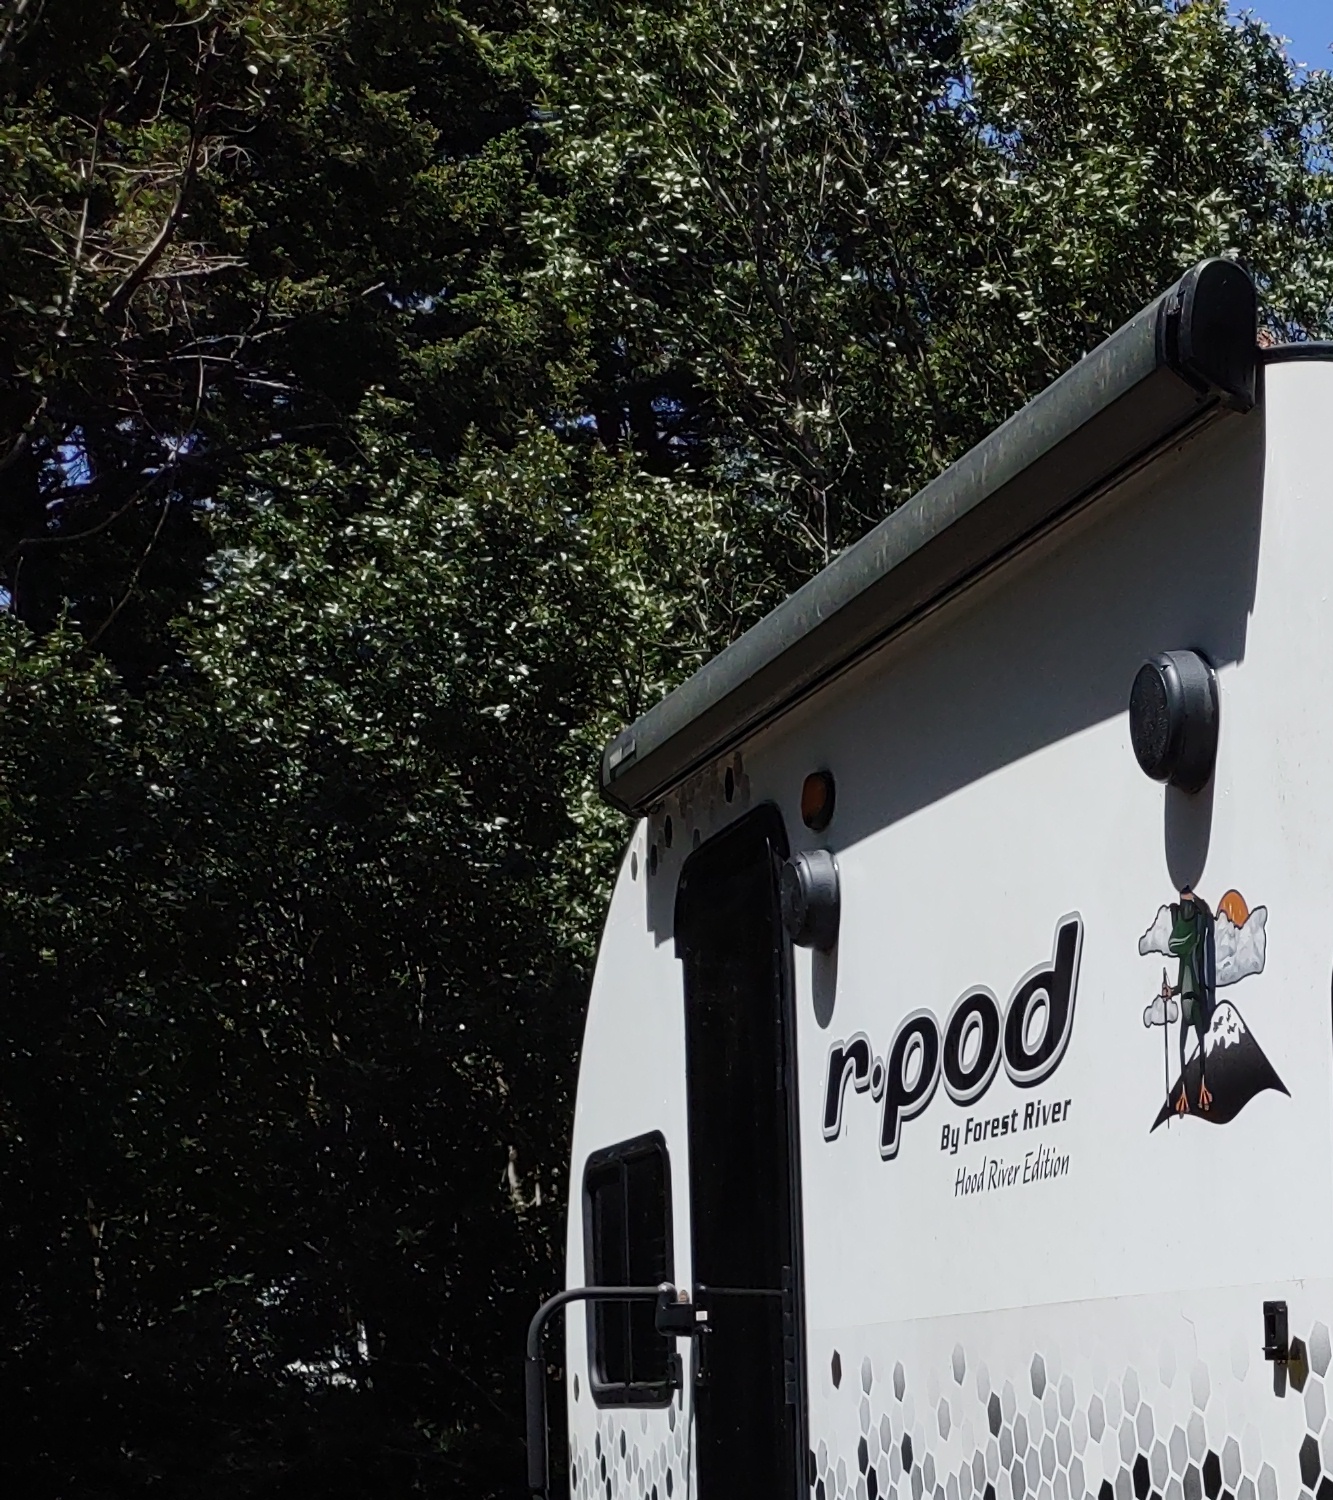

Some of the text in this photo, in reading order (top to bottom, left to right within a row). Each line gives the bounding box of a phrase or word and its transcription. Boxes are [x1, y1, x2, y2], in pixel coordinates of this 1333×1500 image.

[940, 1098, 1072, 1155] By Forest River
[954, 1143, 1070, 1197] Hood River Edition
